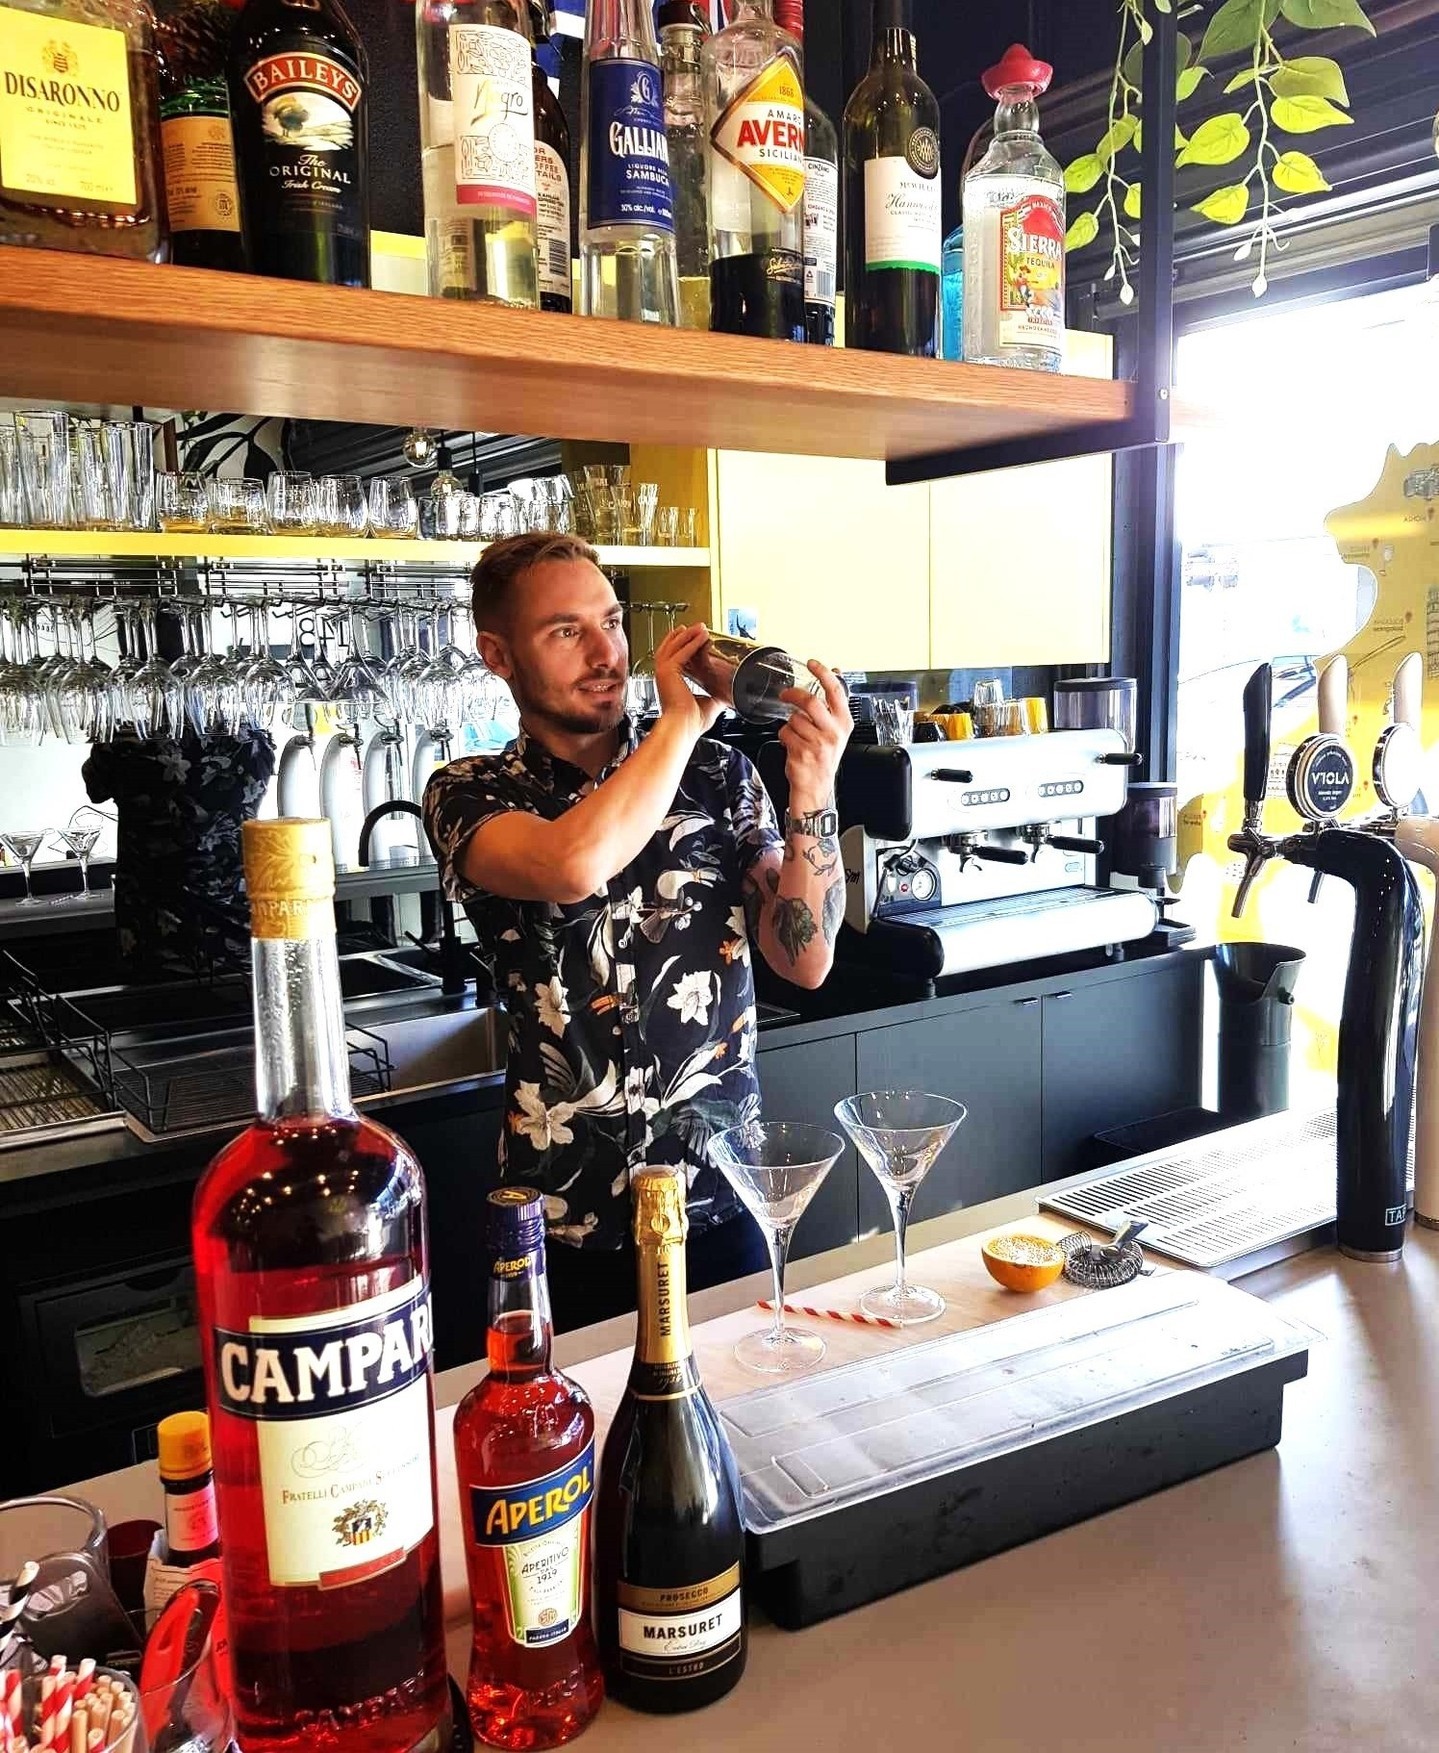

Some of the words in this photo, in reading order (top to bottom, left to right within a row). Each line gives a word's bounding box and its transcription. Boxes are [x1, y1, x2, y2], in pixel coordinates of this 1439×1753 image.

[252, 59, 353, 99] BAILEYS
[4, 71, 120, 113] DISARONNO
[298, 154, 326, 167] The
[269, 166, 351, 184] ORIGINAL
[311, 180, 342, 194] Cream
[1007, 226, 1063, 262] SIERRA
[1026, 256, 1056, 270] TEQUILA
[656, 1261, 672, 1337] MARSURET
[282, 1489, 327, 1504] FRATELLI
[485, 1465, 591, 1535] APEROL
[521, 1546, 569, 1575] APERITIVO
[537, 1568, 558, 1585] 1919
[659, 1586, 709, 1602] PROSECCO
[643, 1613, 723, 1640] MARSURET
